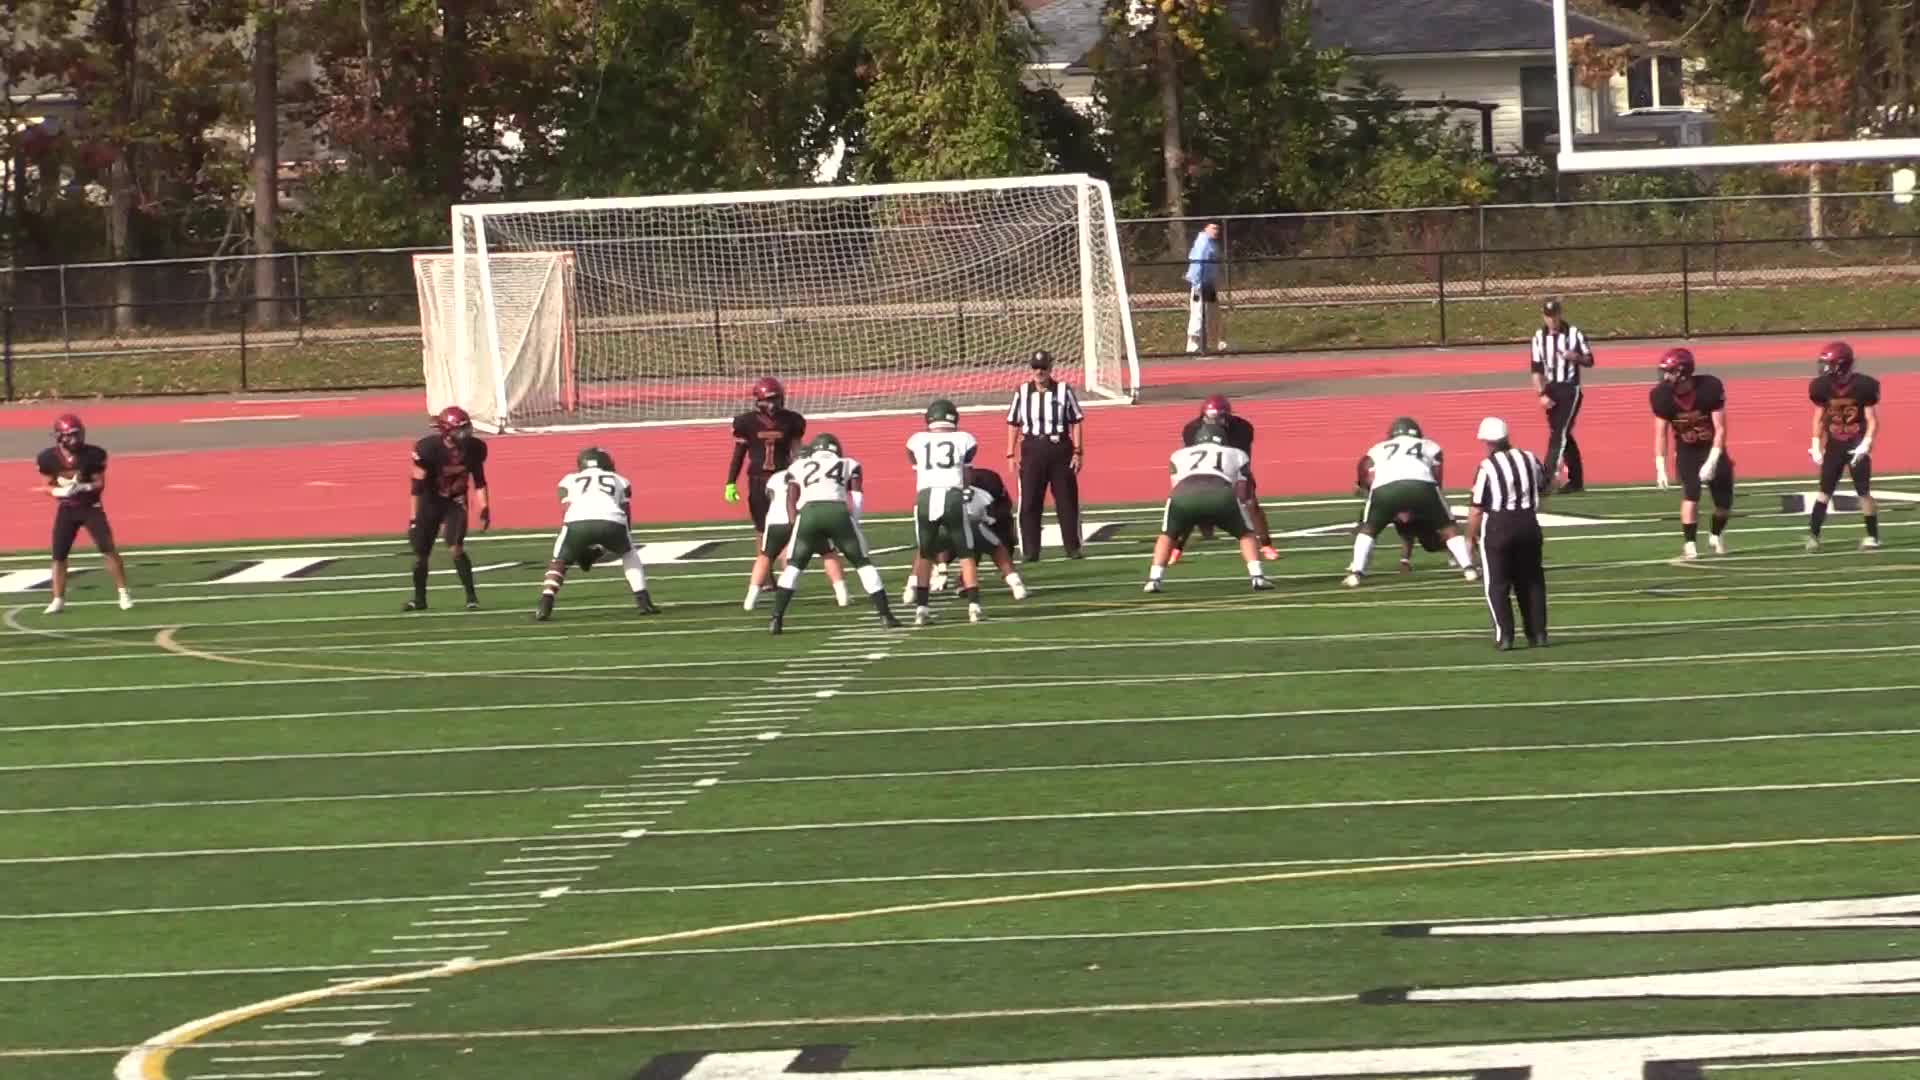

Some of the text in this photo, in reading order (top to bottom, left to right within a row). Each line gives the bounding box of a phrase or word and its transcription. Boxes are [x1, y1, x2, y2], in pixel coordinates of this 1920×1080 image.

[924, 440, 955, 470] 13
[1189, 449, 1223, 472] 71
[1383, 442, 1423, 461] 74
[575, 474, 616, 497] 75
[803, 460, 845, 488] 24
